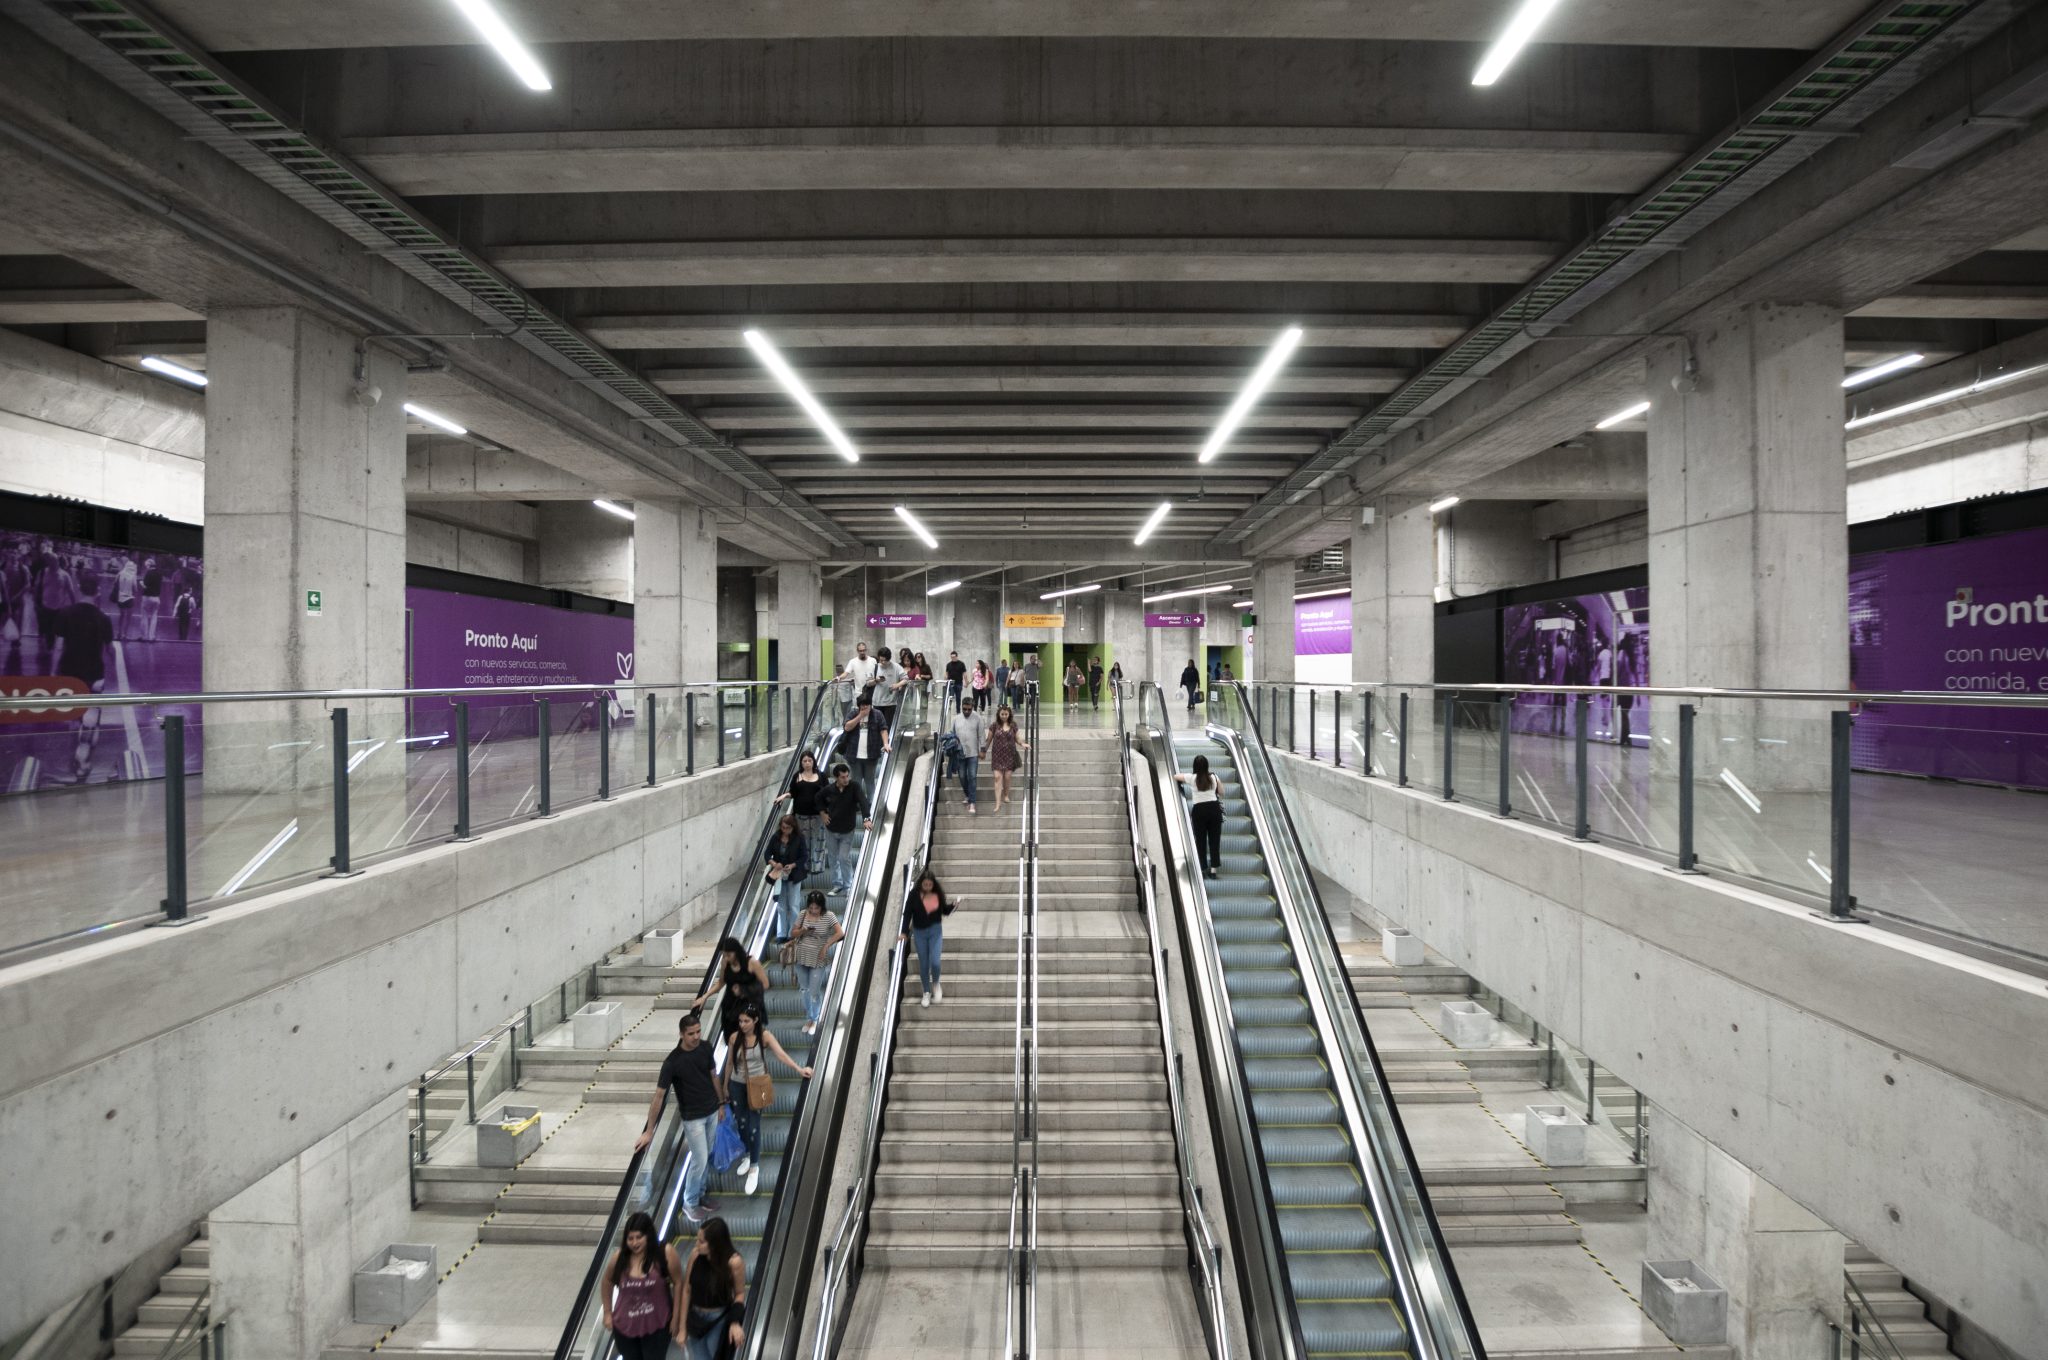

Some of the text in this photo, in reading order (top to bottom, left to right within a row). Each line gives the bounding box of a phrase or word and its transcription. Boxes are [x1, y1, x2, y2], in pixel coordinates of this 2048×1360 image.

[465, 629, 538, 653] Pronto Aquí
[1945, 647, 2048, 663] con nuev
[464, 659, 479, 668] con
[481, 659, 507, 669] nuevos
[464, 673, 495, 685] comida,
[1945, 671, 2031, 692] comida,
